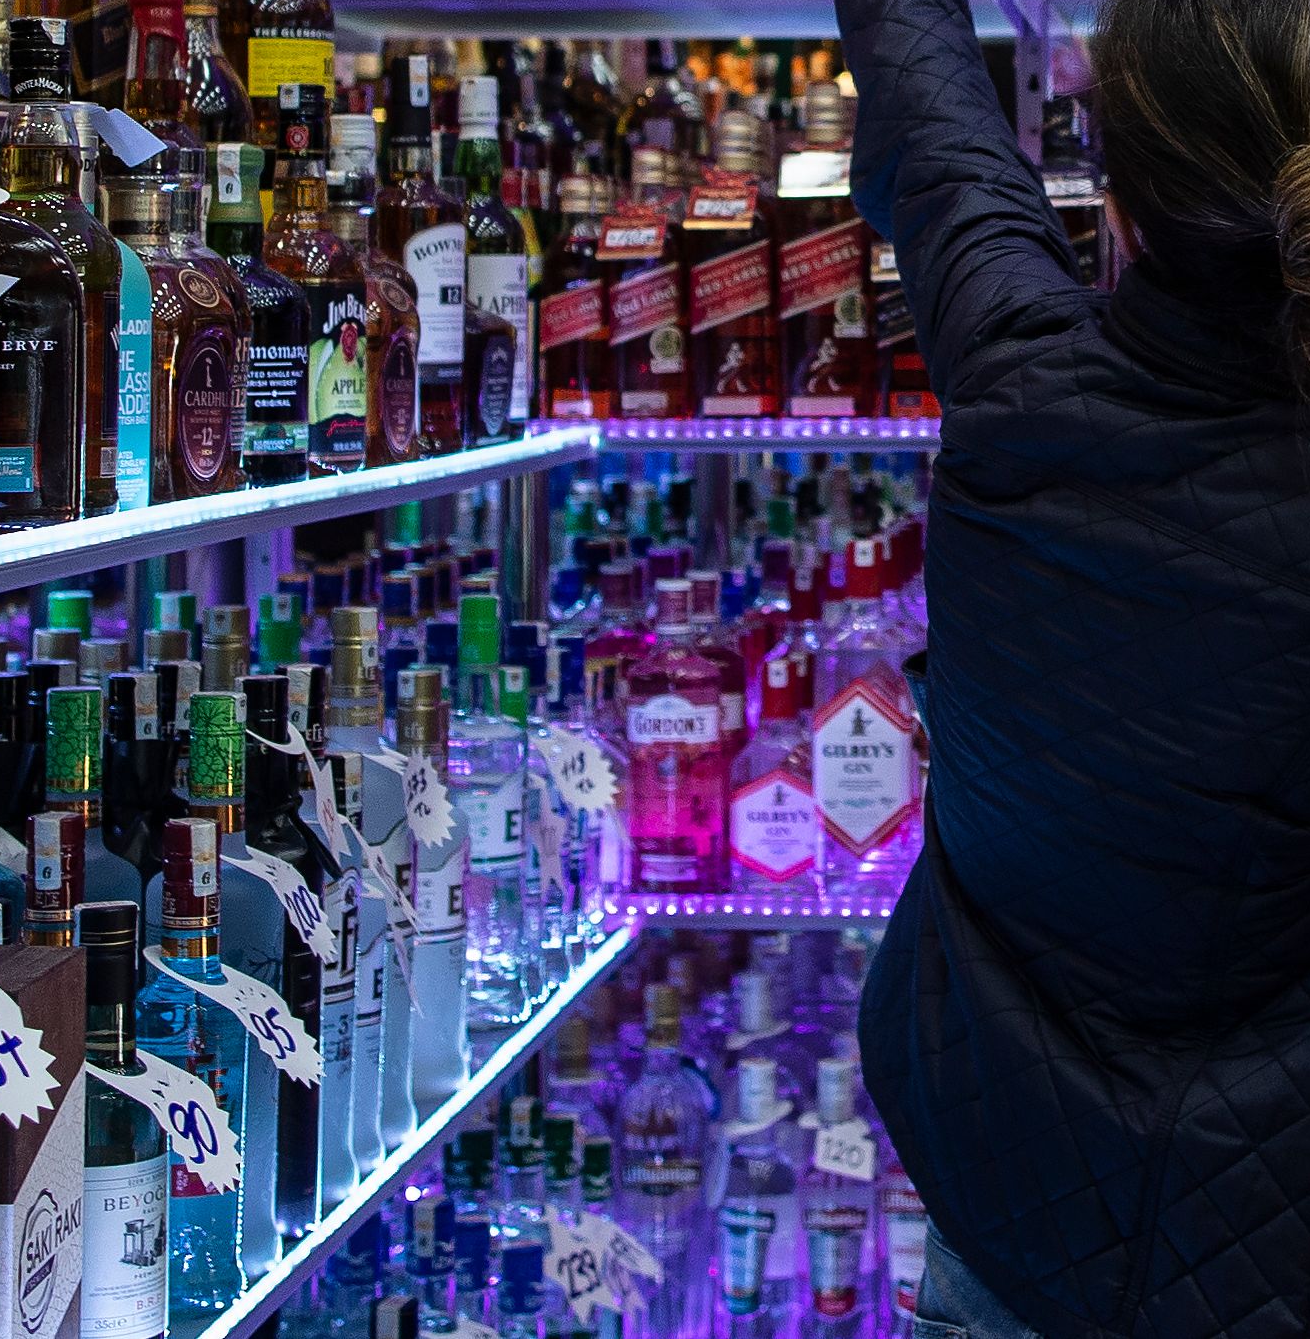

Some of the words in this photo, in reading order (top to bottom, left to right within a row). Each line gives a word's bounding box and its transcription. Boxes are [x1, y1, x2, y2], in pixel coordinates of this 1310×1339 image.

[323, 300, 345, 334] JIM
[118, 350, 135, 371] HE
[331, 378, 366, 396] APPLE
[201, 426, 213, 447] 12
[632, 710, 707, 738] GORDON'S
[822, 743, 896, 759] GILBEY'S
[746, 810, 811, 824] GILBEY'S
[250, 1006, 297, 1061] 95
[169, 1100, 220, 1166] 90
[821, 1137, 863, 1167] 120
[25, 1221, 55, 1275] SAKI
[54, 1197, 83, 1247] RAKI
